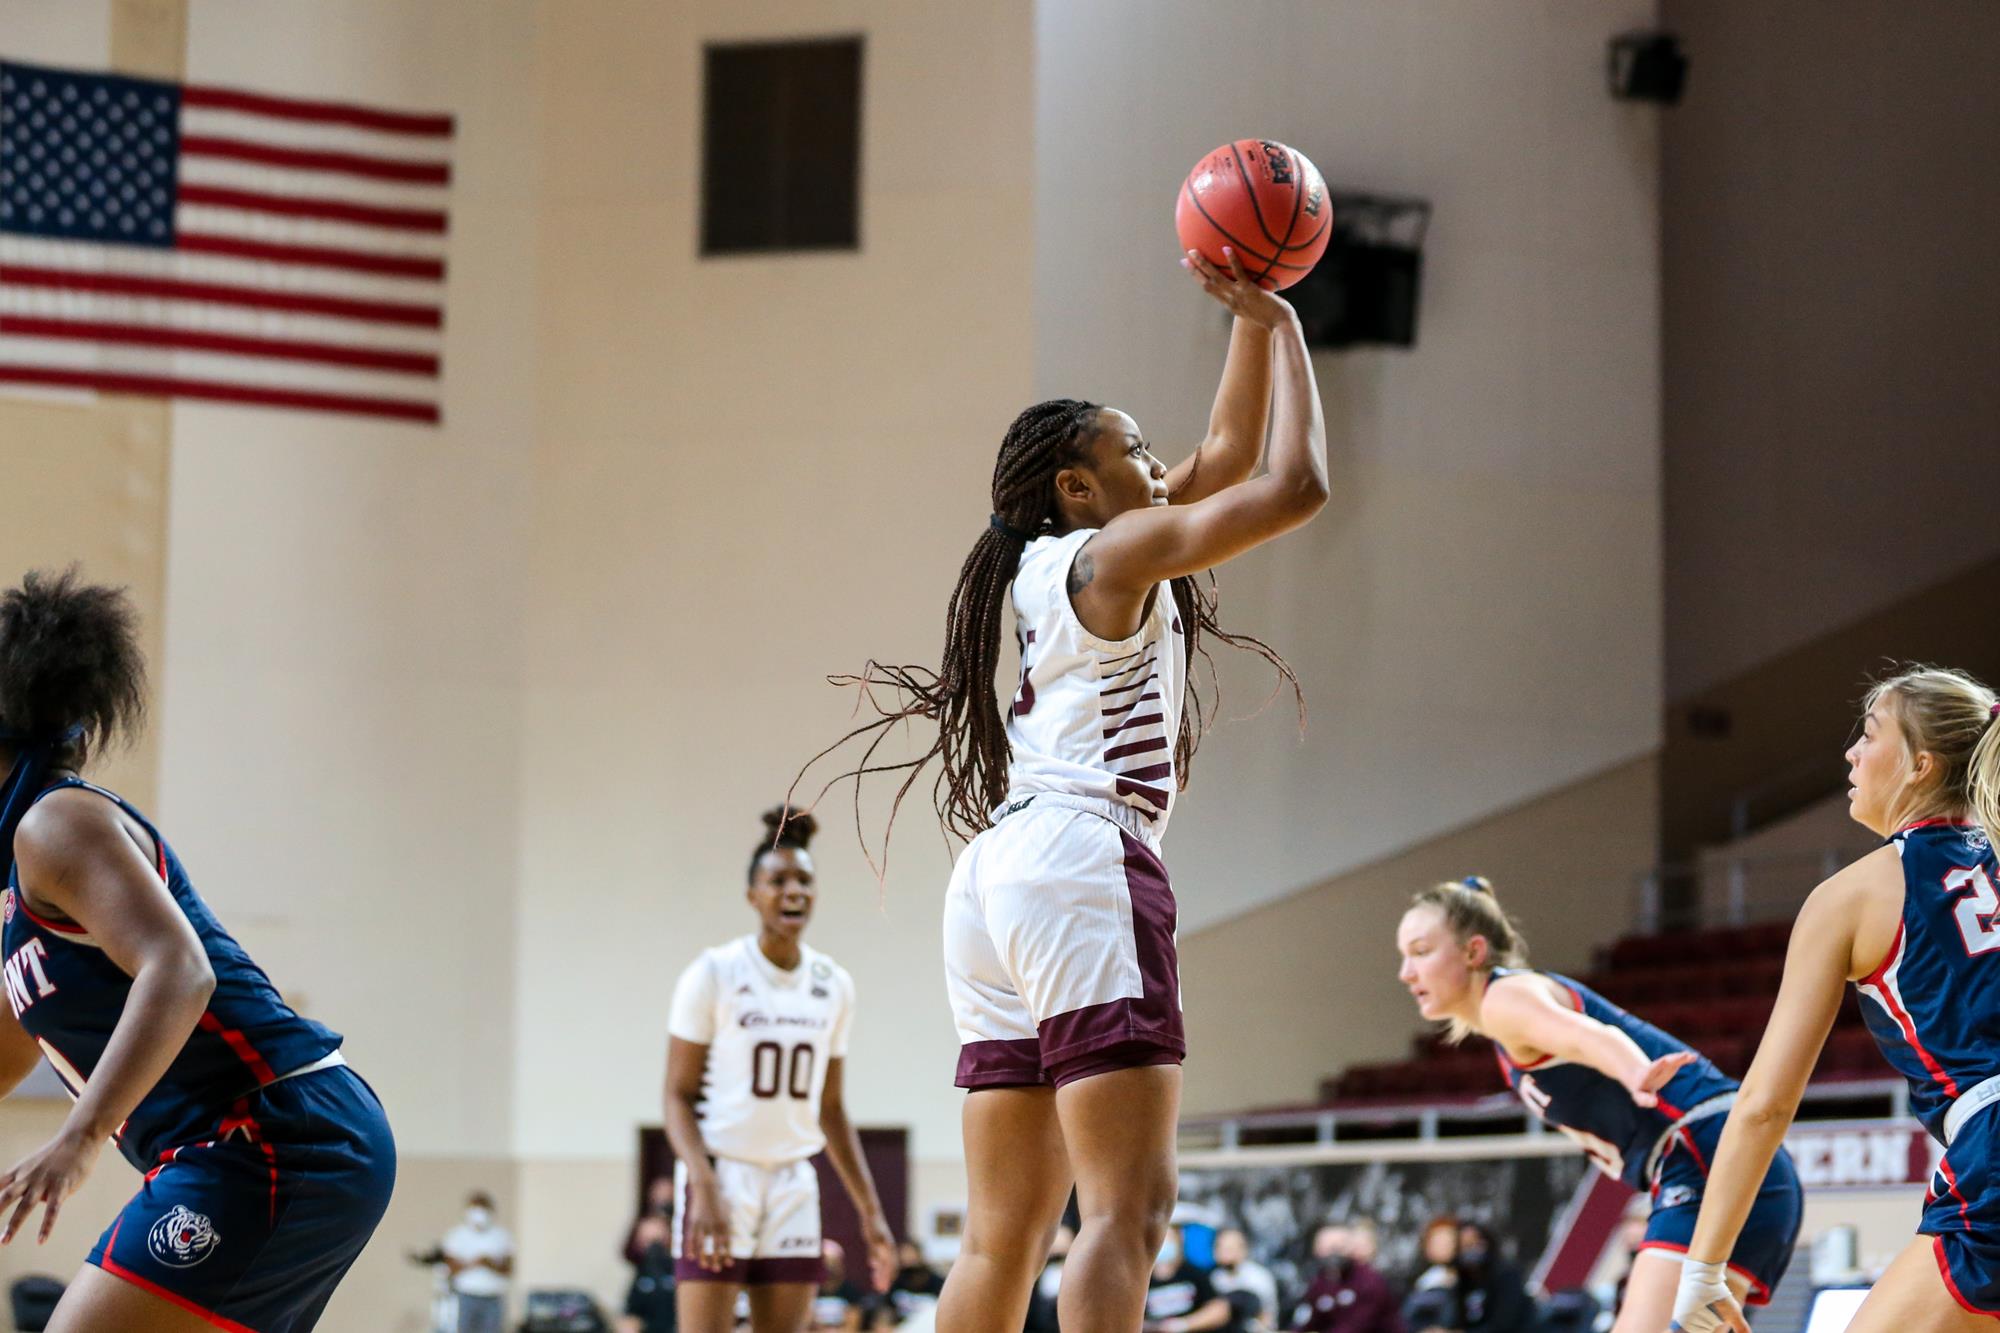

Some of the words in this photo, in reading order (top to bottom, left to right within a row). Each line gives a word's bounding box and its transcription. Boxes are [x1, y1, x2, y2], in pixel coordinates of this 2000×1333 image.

[1942, 864, 2000, 957] 2
[3, 936, 57, 1020] NT
[753, 1041, 814, 1099] 00
[1788, 1132, 1910, 1184] ERN
